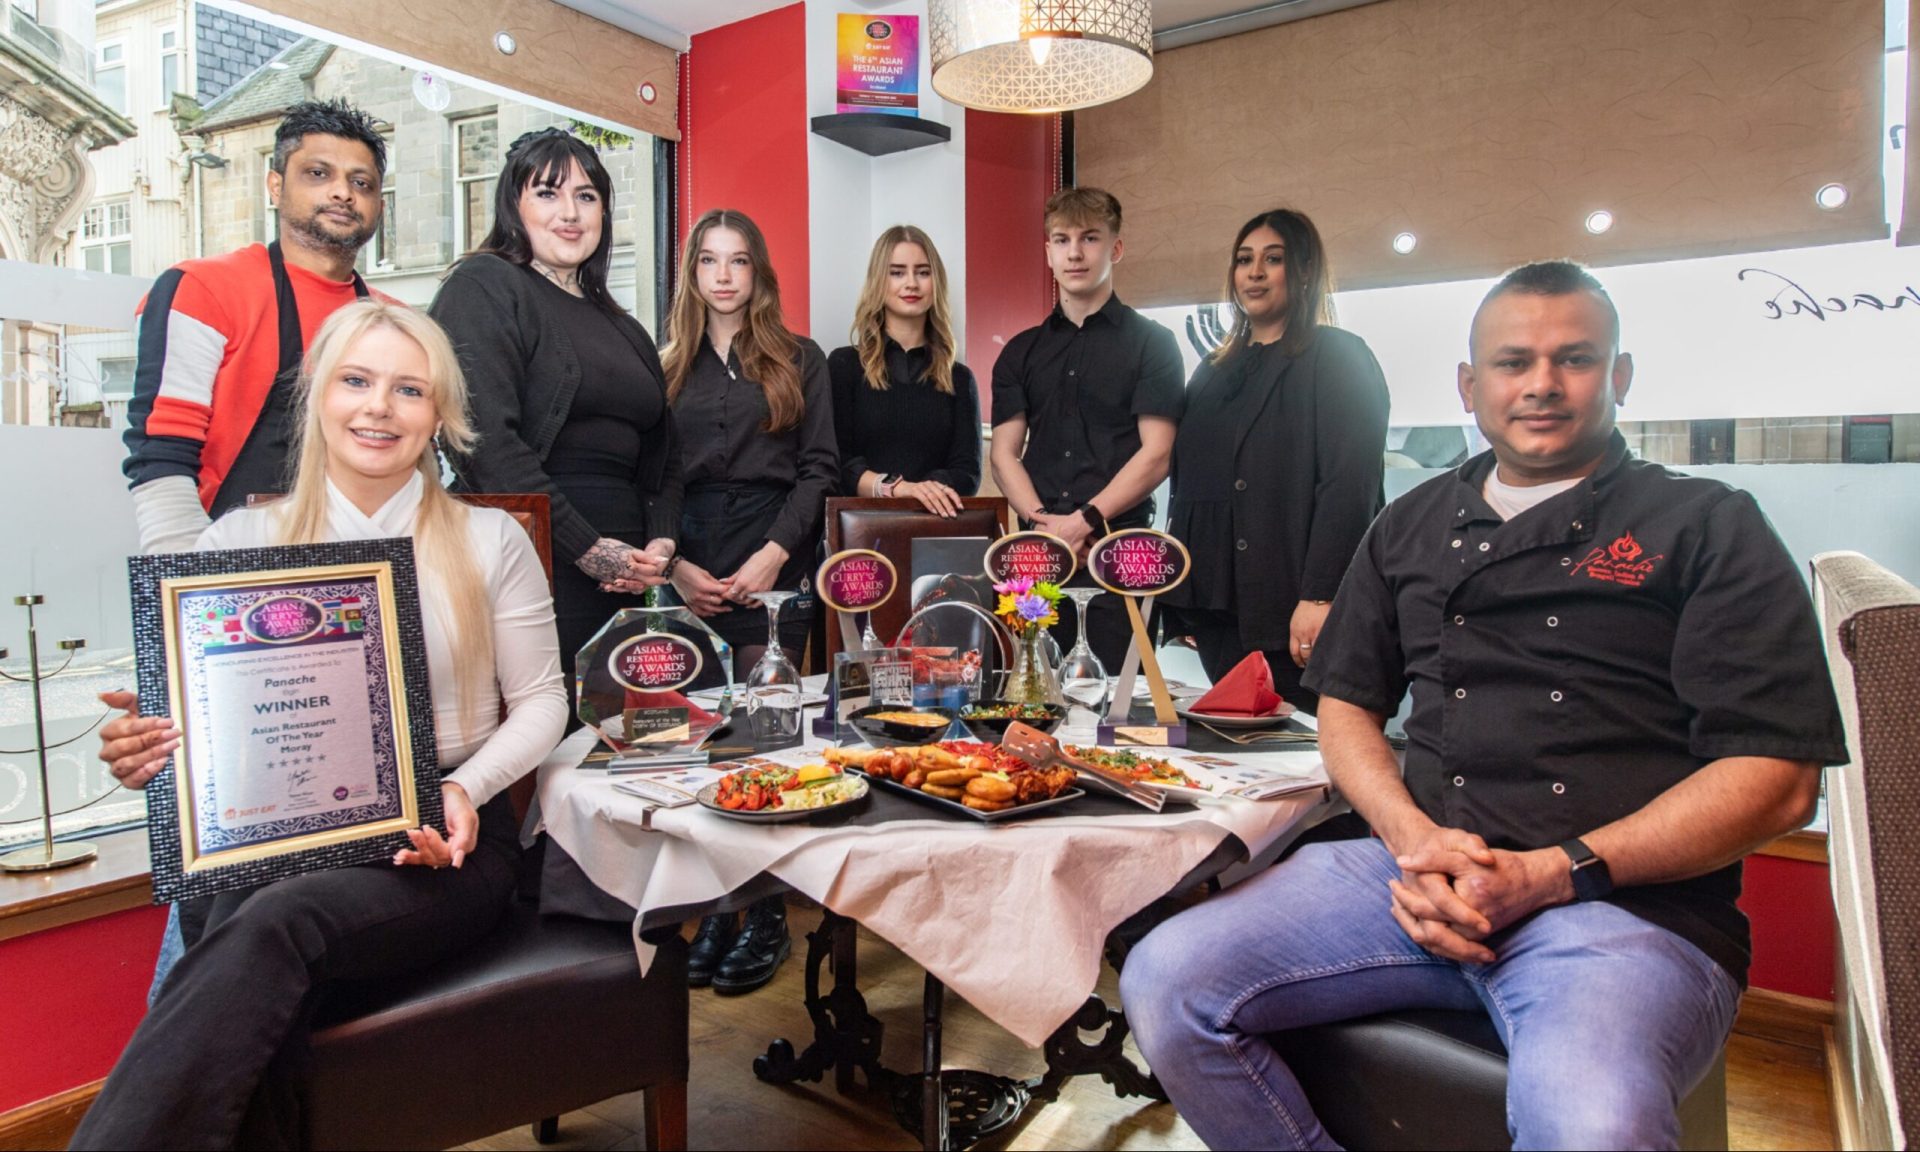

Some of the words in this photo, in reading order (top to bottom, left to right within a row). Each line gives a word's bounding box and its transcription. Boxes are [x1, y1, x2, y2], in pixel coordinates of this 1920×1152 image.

[853, 55, 865, 64] THE
[879, 57, 903, 65] ASIAN
[853, 64, 903, 75] RESTAURANT
[861, 74, 895, 84] AWARDS
[1008, 544, 1040, 553] ASIAN
[1113, 539, 1156, 551] ASIAN
[1001, 554, 1060, 562] RESTAURANT
[1100, 549, 1149, 563] CURRY
[839, 561, 870, 571] ASIAN
[1570, 547, 1664, 576] Panache
[1011, 563, 1061, 573] AWARDS
[1115, 562, 1175, 575] AWARDS
[831, 572, 865, 583] CURRY
[1142, 574, 1166, 585] 2023
[841, 581, 883, 591] AWARDS
[863, 590, 880, 599] 2019
[261, 603, 298, 613] ASIAN
[251, 612, 293, 623] CURRY
[265, 617, 315, 629] AWARDS
[633, 645, 664, 654] ASIAN
[626, 654, 685, 663] RESTAURANT
[636, 662, 686, 673] AWARDS
[264, 675, 317, 688] Panache
[661, 672, 681, 681] 2022
[253, 695, 331, 714] WINNER
[251, 726, 280, 735] Asian
[282, 718, 336, 731] Restaurant
[265, 736, 280, 745] Of
[281, 733, 301, 742] The
[302, 731, 324, 739] Year
[280, 744, 312, 753] Moray
[260, 804, 276, 813] EAT
